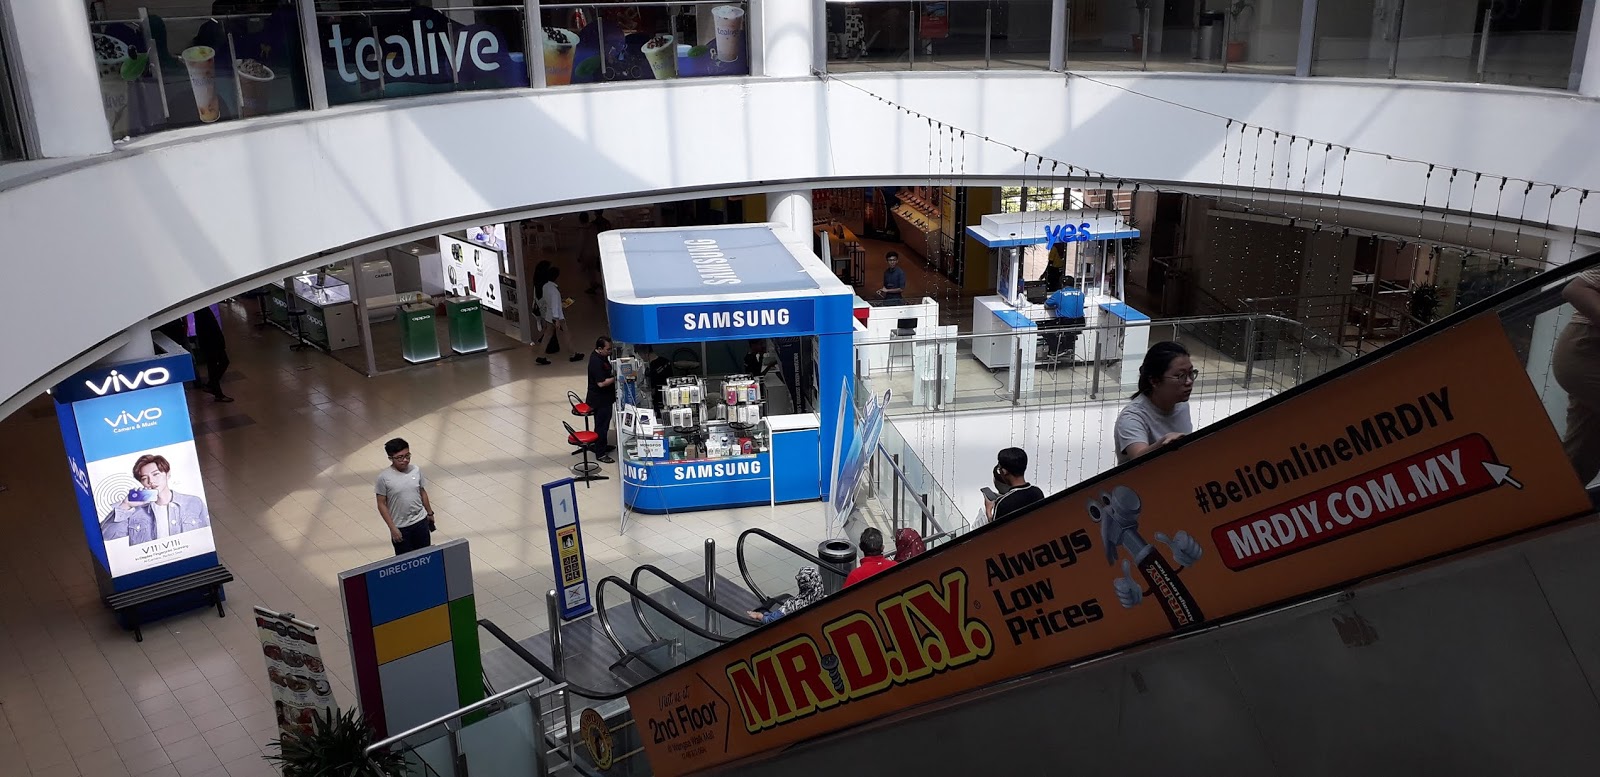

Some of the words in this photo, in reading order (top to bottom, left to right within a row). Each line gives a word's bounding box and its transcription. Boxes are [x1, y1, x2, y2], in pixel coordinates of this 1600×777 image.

[328, 19, 500, 83] tealive
[1044, 222, 1091, 250] yes
[683, 239, 742, 286] SAMSUNG
[683, 308, 790, 331] SAMSUNG
[85, 366, 170, 395] vivo
[104, 407, 162, 428] vivo
[113, 424, 136, 434] Camera
[141, 420, 158, 428] Music
[1194, 386, 1455, 514] #BeliOnlineMRDIY
[674, 461, 761, 480] SAMSUNG
[560, 498, 567, 513] 1
[1226, 448, 1467, 560] MRDIY.COM.MY
[379, 556, 431, 578] DIRECTORY
[985, 528, 1092, 586] Always
[993, 578, 1055, 616] Low
[1005, 598, 1104, 646] Prices
[649, 711, 680, 744] 2nd
[676, 700, 719, 734] Floor
